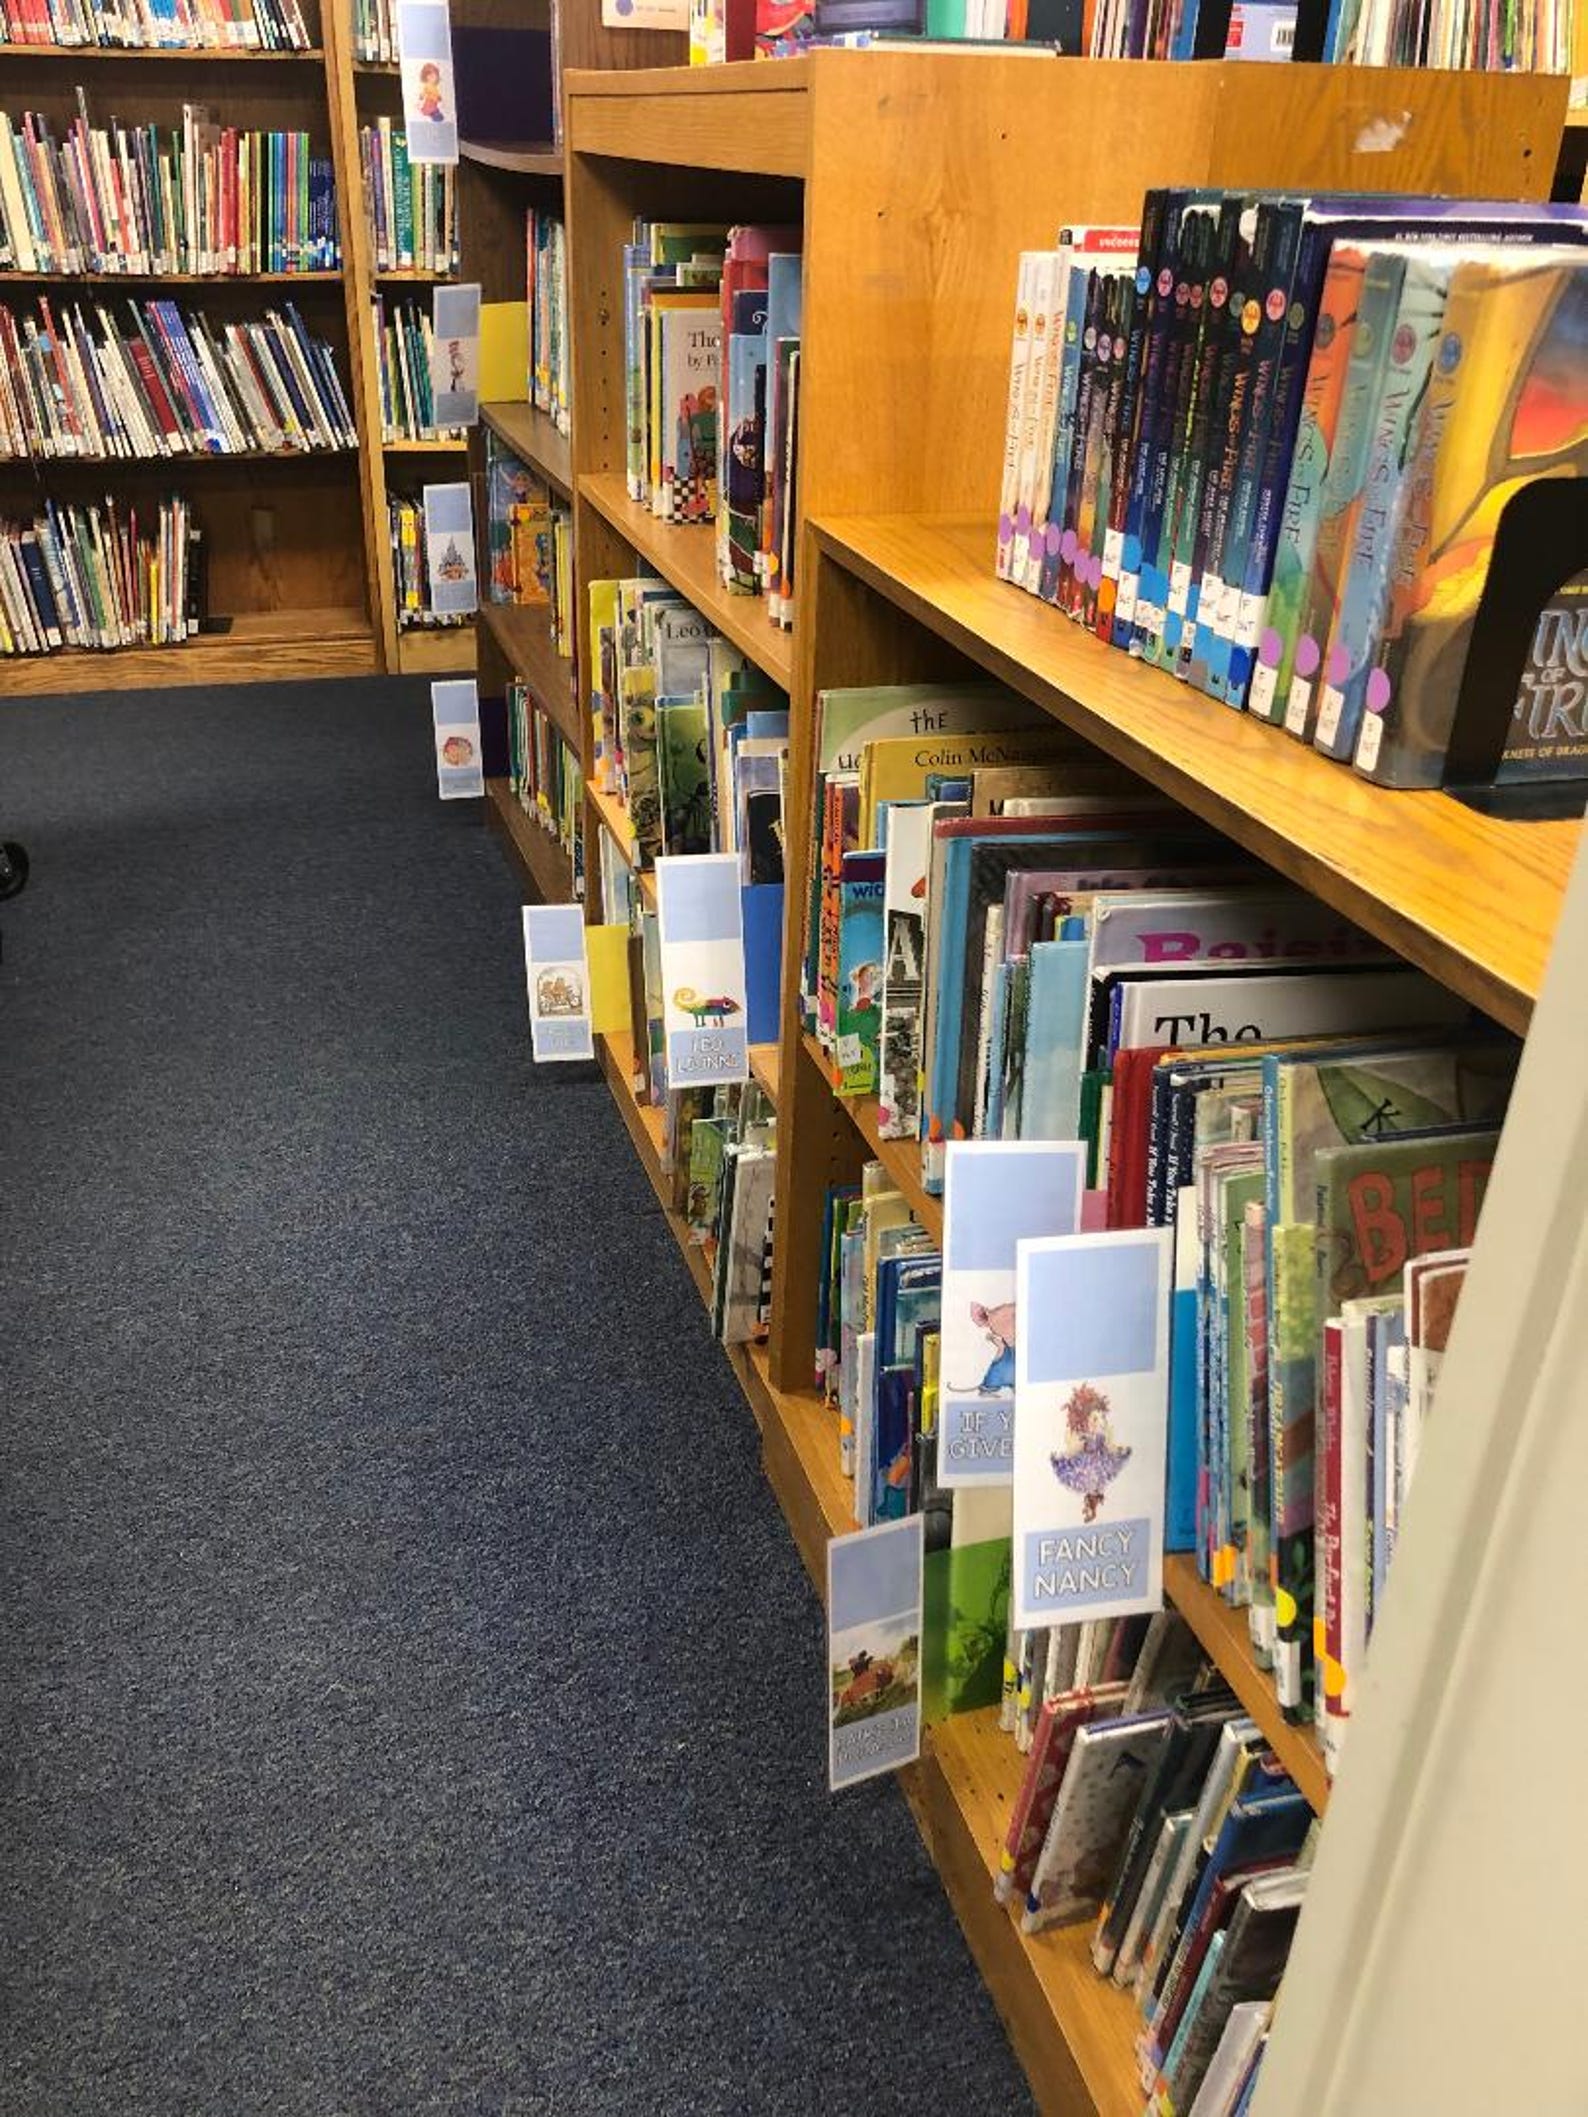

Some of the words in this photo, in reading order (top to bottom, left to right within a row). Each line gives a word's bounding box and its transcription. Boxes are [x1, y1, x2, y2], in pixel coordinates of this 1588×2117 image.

[666, 622, 701, 639] Leo
[1541, 668, 1564, 682] OF
[910, 709, 948, 733] the
[914, 749, 962, 767] Colin
[1502, 749, 1536, 760] KNESS
[886, 916, 919, 981] A
[691, 1036, 723, 1053] LEO
[1148, 1145, 1158, 1157] If
[1168, 1153, 1179, 1165] If
[1147, 1157, 1157, 1176] You
[1167, 1167, 1179, 1185] You
[1146, 1177, 1157, 1203] Take
[1165, 1187, 1178, 1211] Take
[961, 1410, 986, 1433] IF
[950, 1438, 1013, 1460] GIVE
[1323, 1501, 1339, 1529] The
[1038, 1529, 1135, 1567] FANCY
[1325, 1534, 1341, 1605] Perfect
[1033, 1563, 1136, 1600] NANCY
